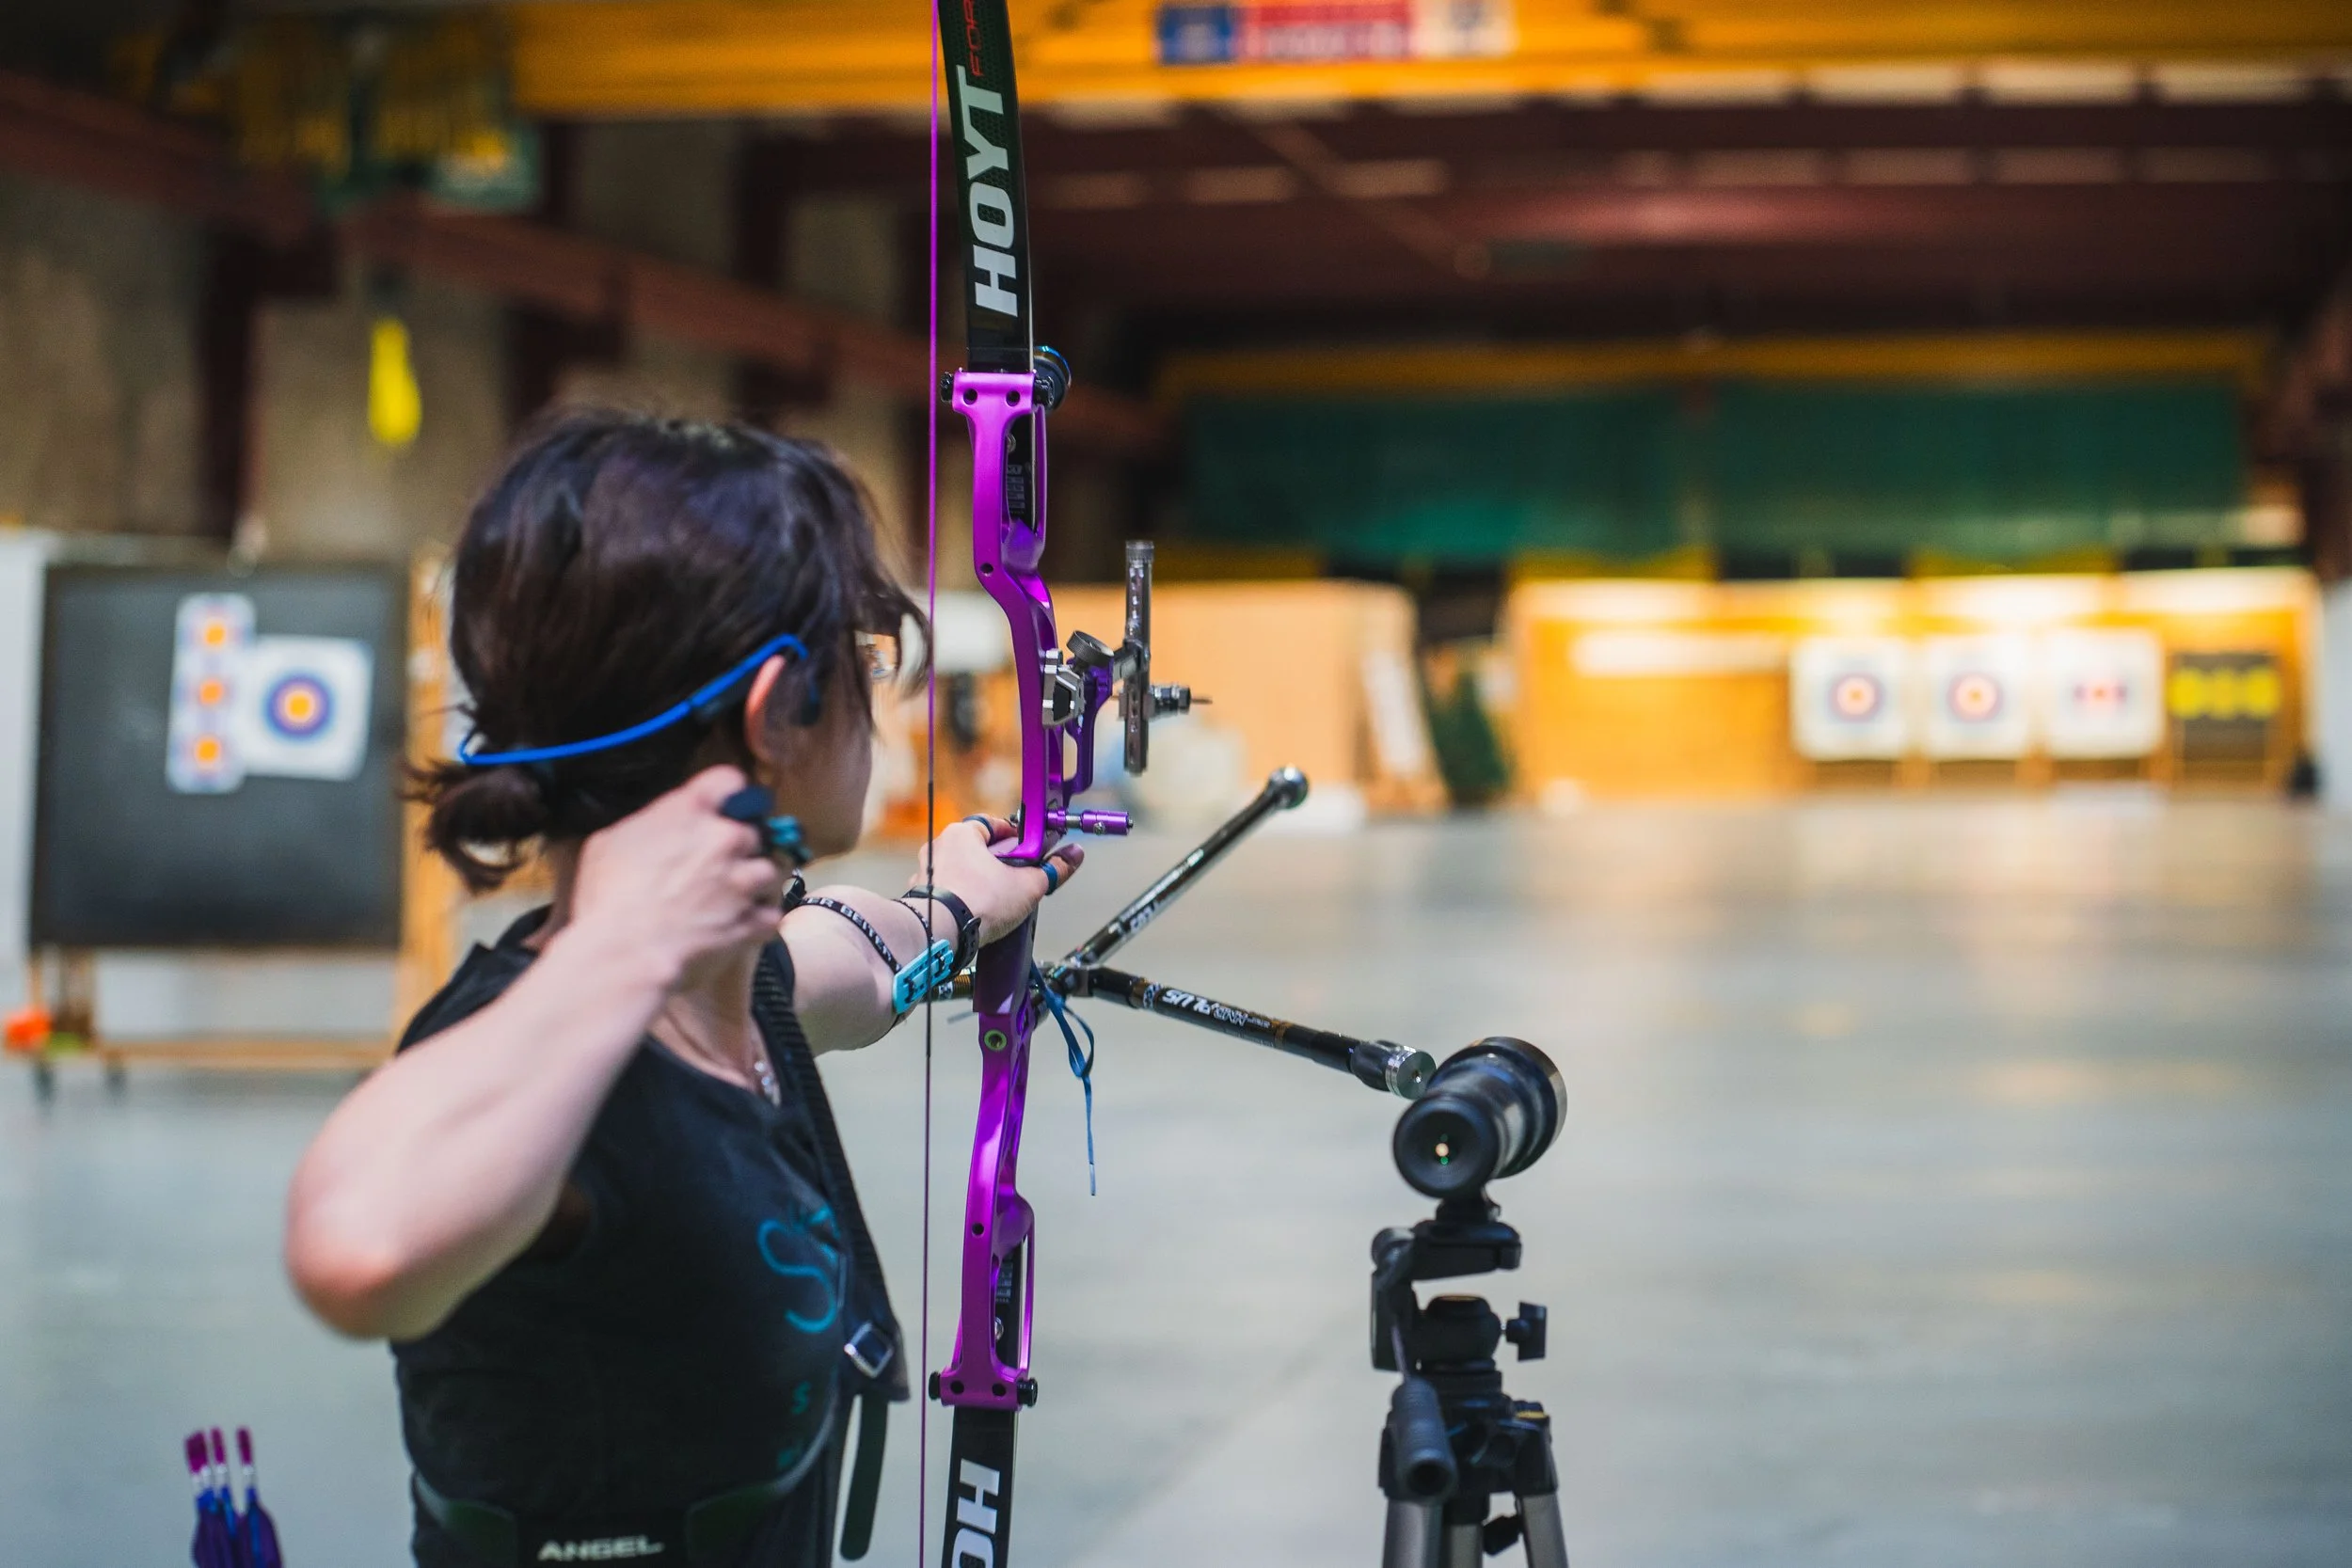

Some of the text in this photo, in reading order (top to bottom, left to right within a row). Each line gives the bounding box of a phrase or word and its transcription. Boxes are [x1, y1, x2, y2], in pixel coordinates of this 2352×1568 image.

[956, 64, 1018, 318] HOYT
[840, 904, 892, 962] BEITER
[1162, 989, 1212, 1016] PLUS
[537, 1535, 664, 1561] ANGEL
